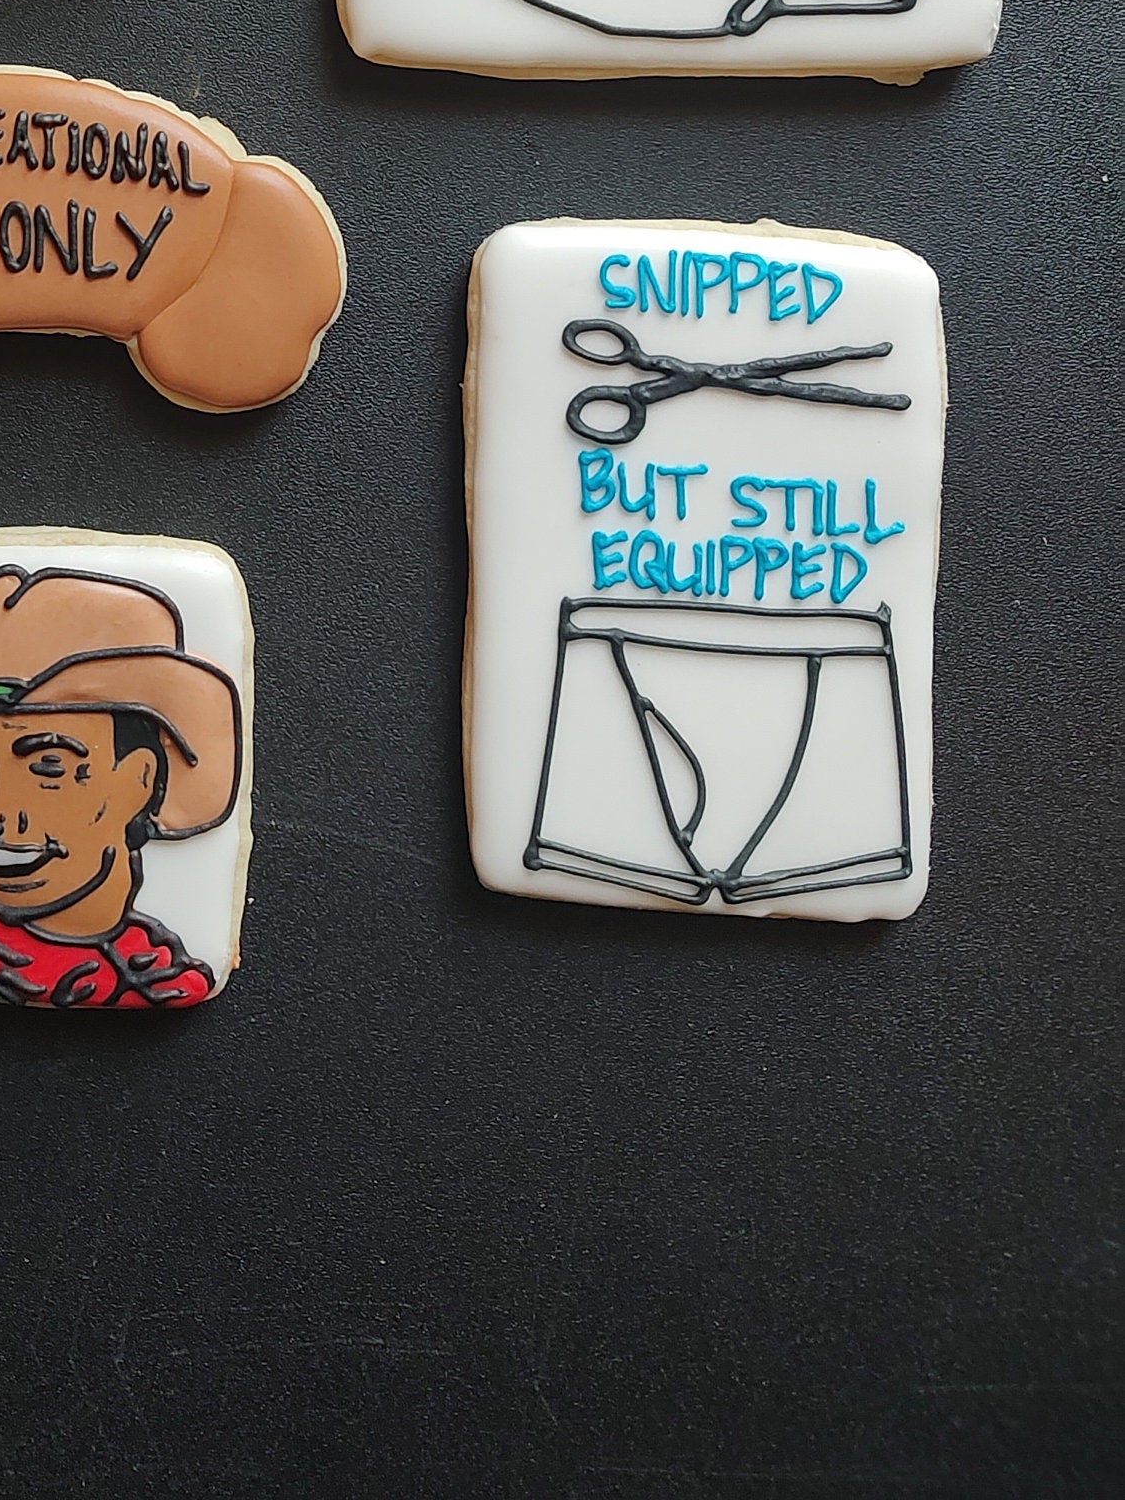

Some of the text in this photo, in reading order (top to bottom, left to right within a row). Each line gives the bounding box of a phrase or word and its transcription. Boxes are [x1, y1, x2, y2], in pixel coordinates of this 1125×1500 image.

[598, 249, 843, 325] SNIPPED
[577, 448, 905, 544] BUT STILL
[591, 528, 868, 603] EQUIPPED
